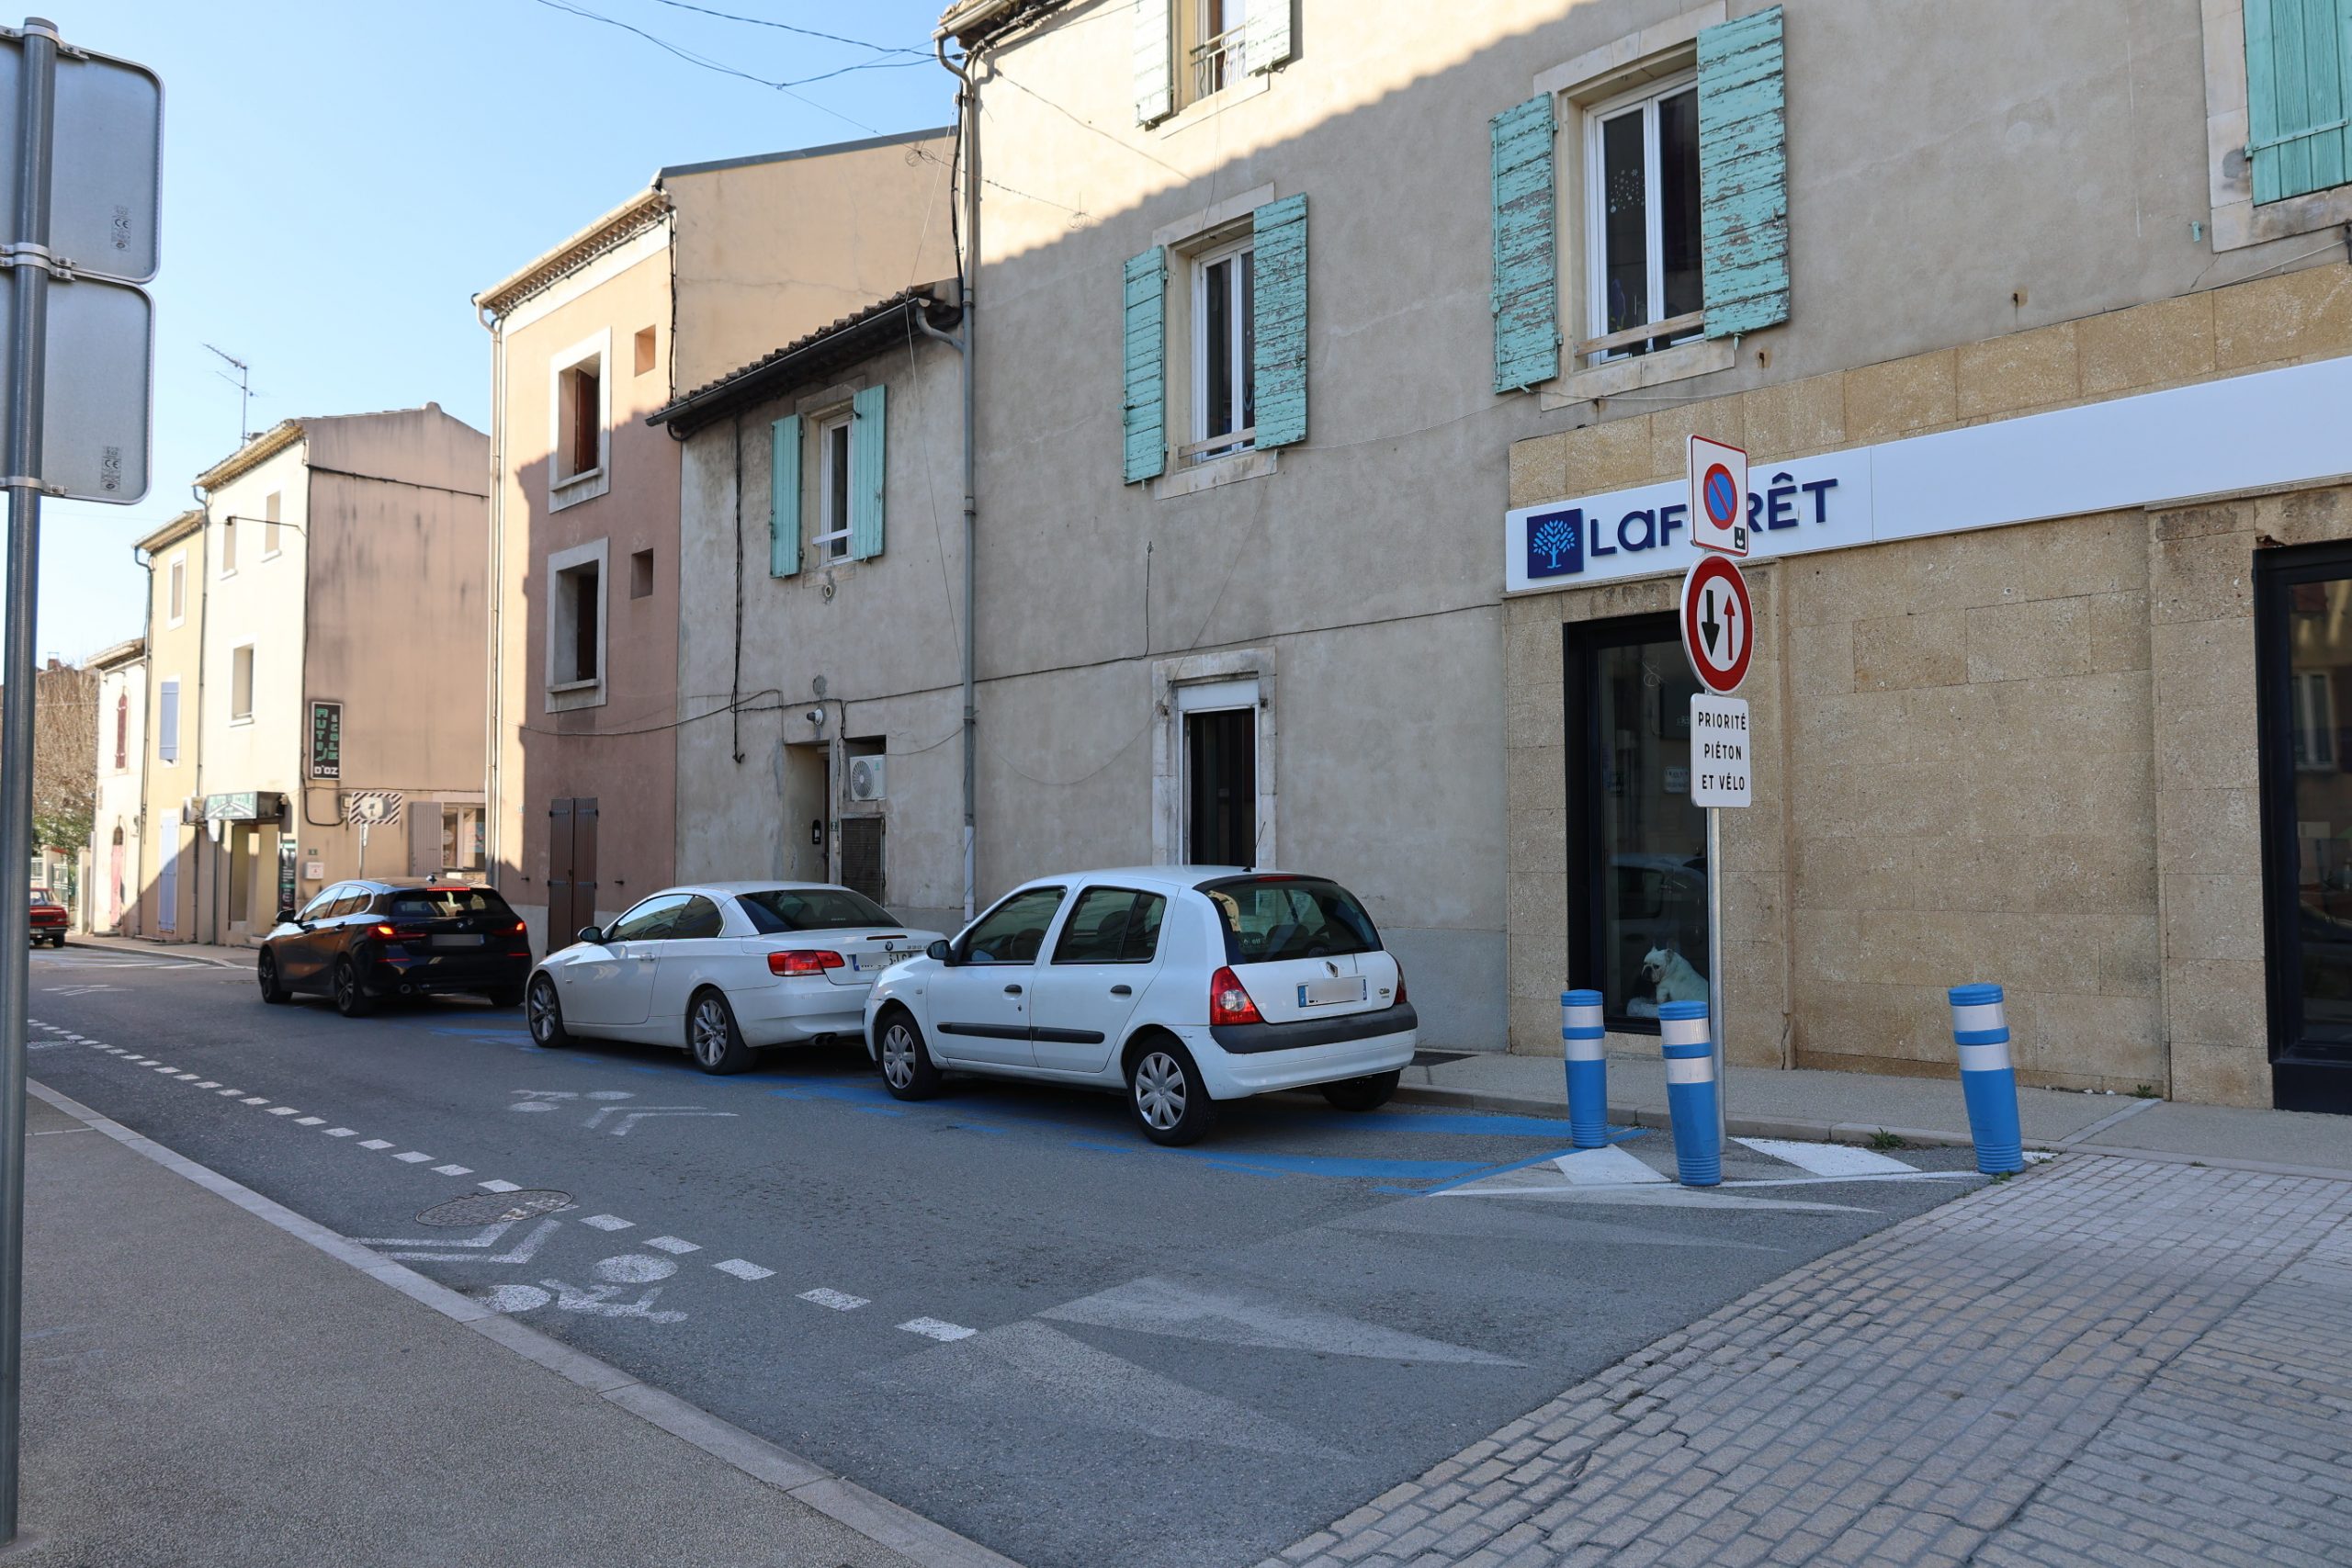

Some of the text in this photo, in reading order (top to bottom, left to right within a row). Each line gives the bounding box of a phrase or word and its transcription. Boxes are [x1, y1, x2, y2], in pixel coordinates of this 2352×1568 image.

[1698, 711, 1747, 730] PRIORITÉ
[1704, 741, 1742, 761] PIÉTON
[1702, 774, 1714, 790] ET
[1719, 773, 1745, 791] VÉLO
